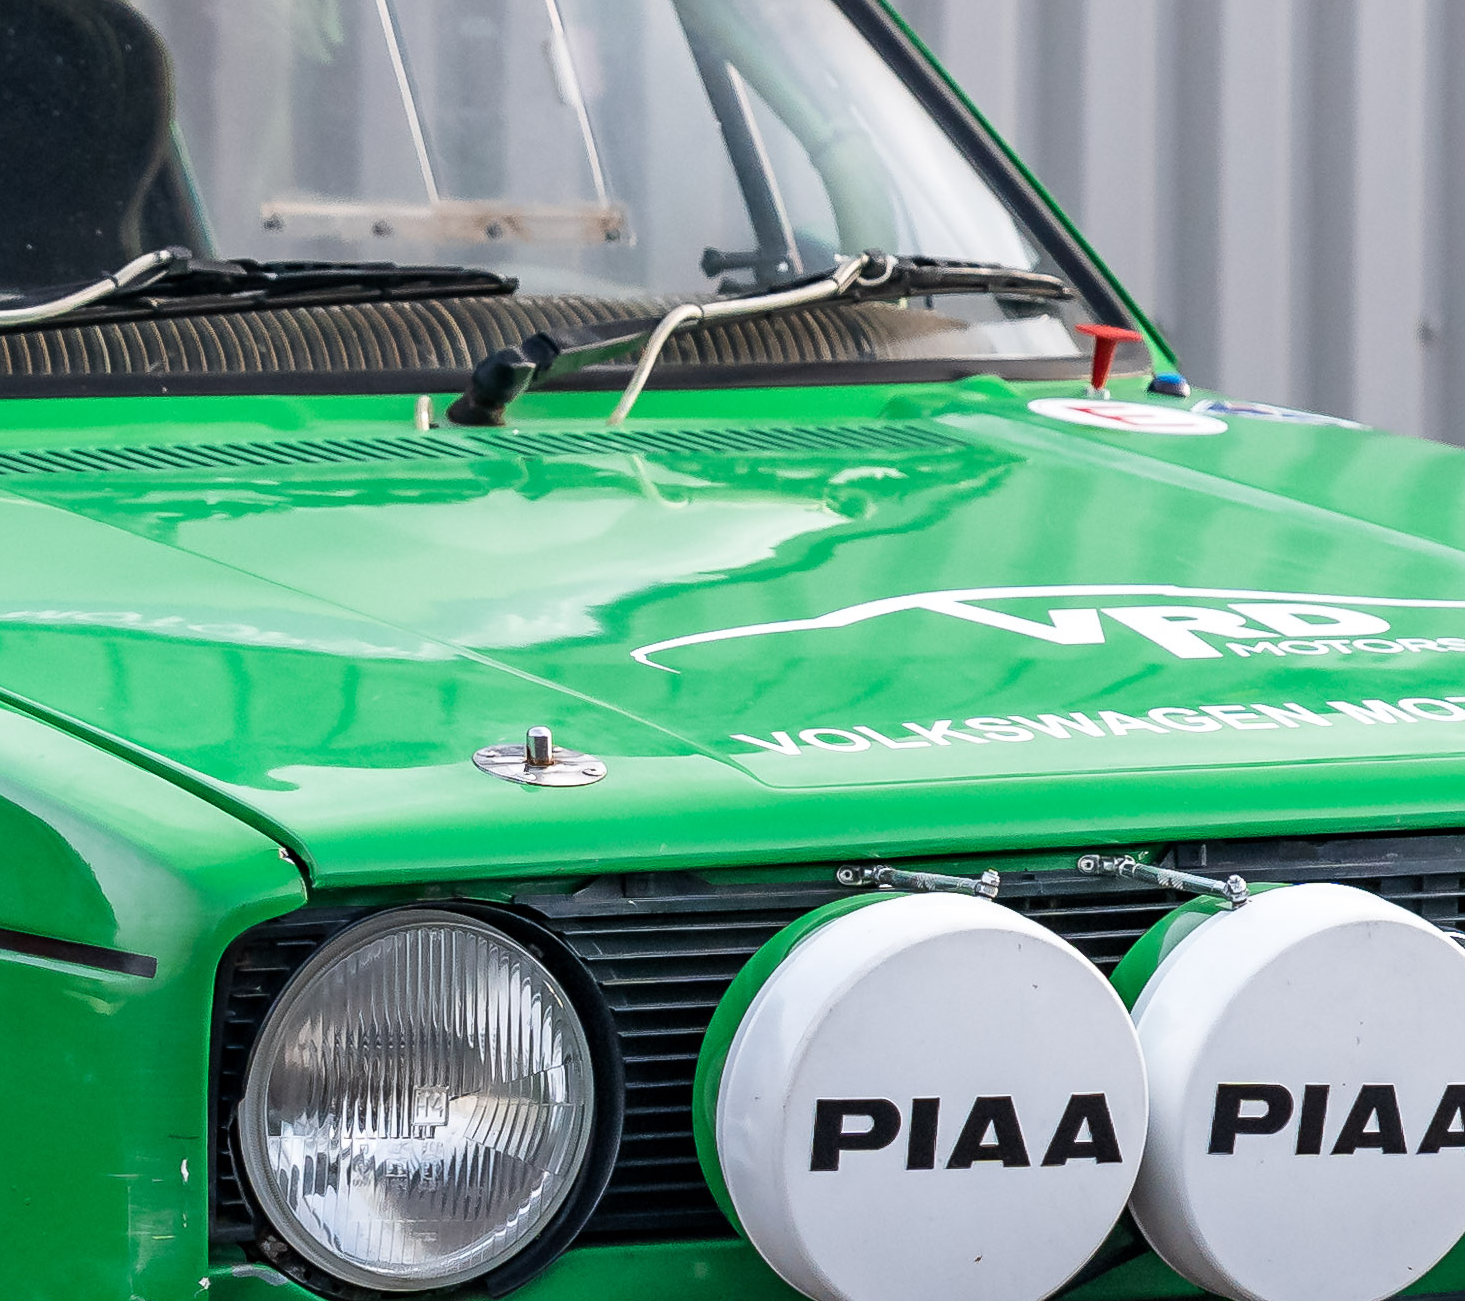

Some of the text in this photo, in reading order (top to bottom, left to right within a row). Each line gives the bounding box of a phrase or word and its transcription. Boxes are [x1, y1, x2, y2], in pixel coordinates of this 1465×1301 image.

[913, 591, 1391, 660] VRD
[728, 702, 1333, 757] VOLKSWAGEN
[809, 1092, 1125, 1173] PIAA
